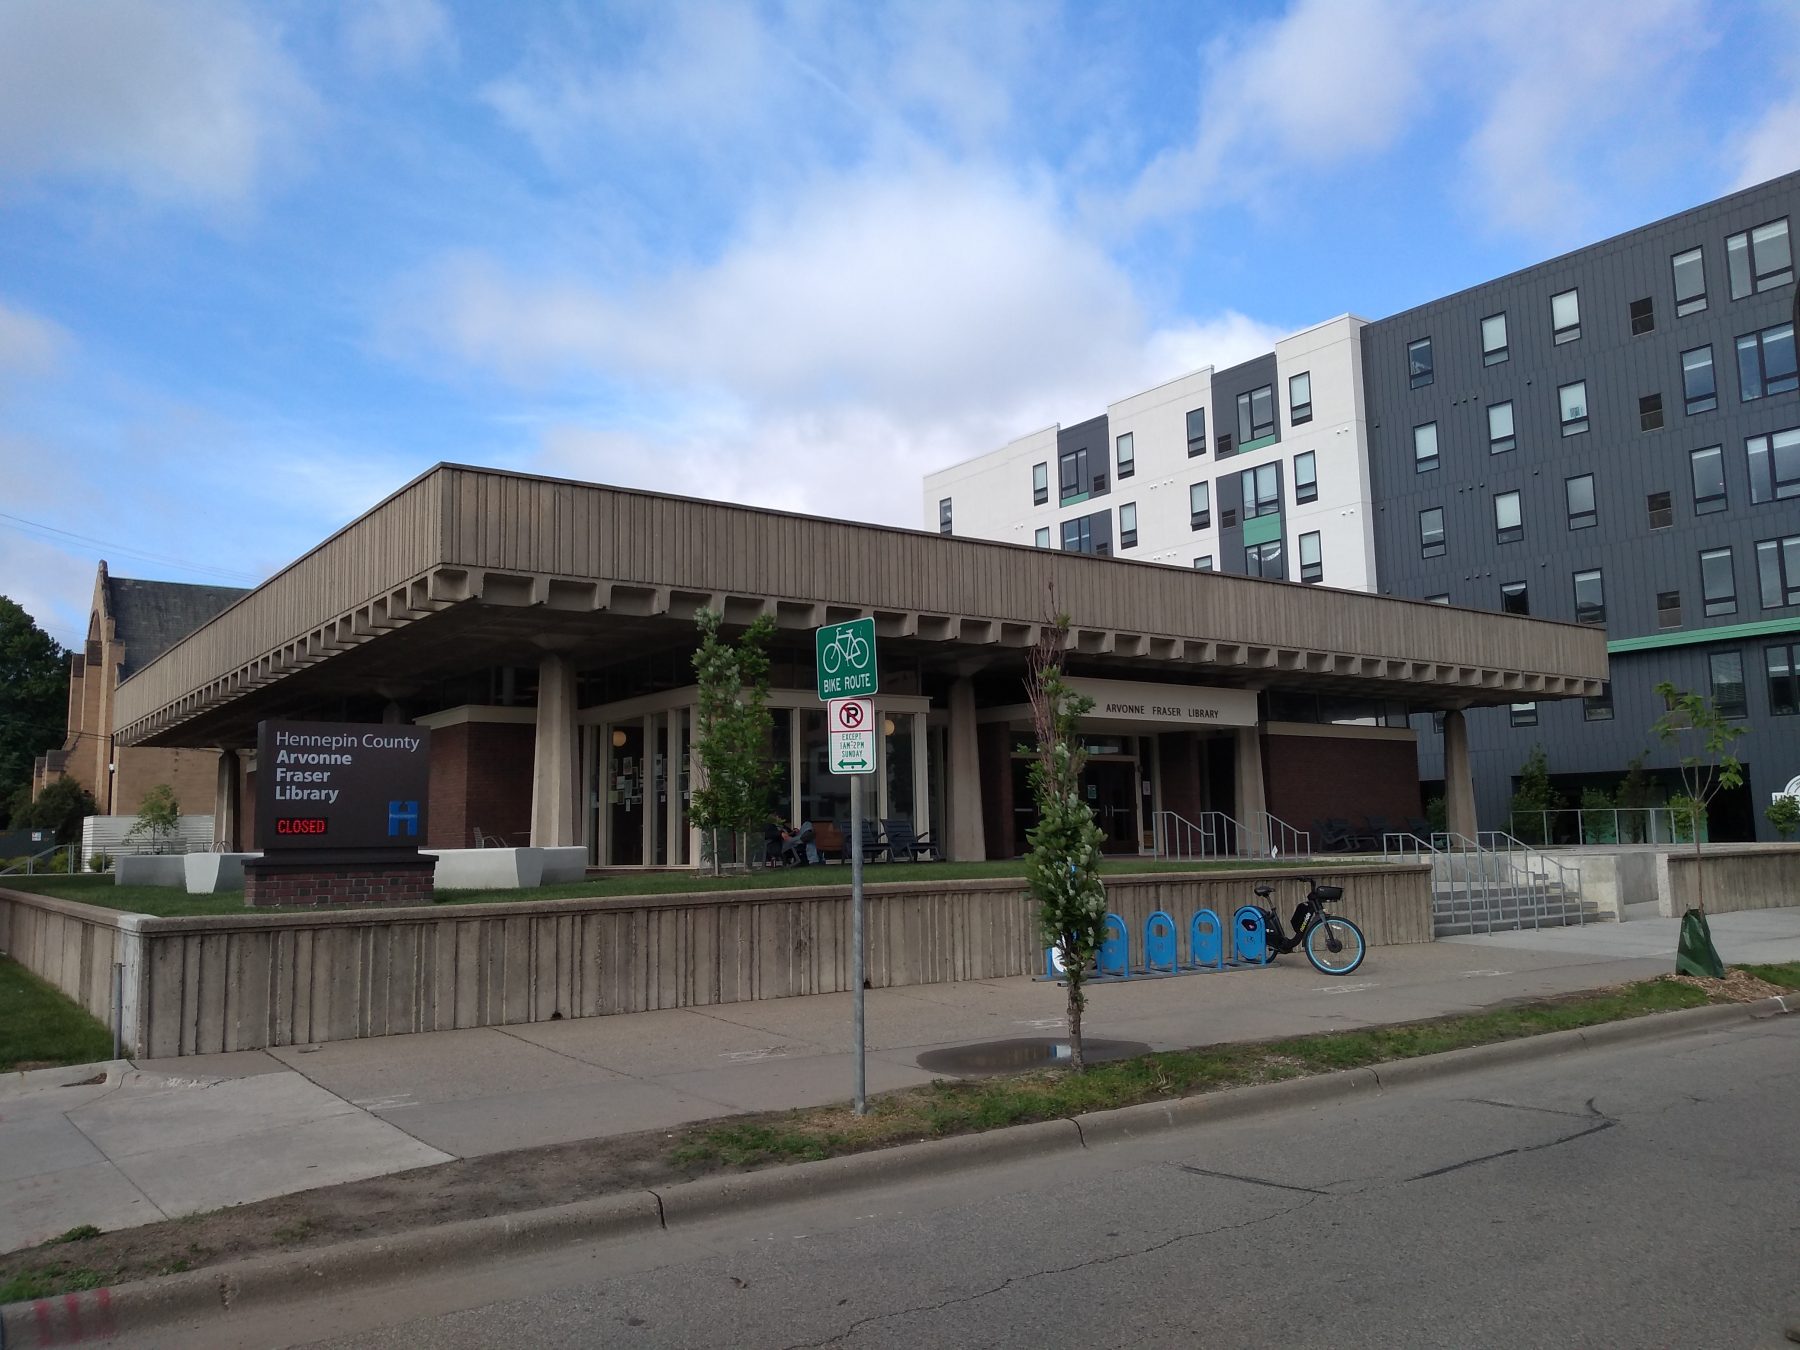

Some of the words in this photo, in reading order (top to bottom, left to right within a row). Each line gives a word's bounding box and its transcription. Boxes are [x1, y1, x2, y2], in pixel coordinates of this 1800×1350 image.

[824, 678, 841, 692] BIKE
[845, 674, 871, 690] ROUTE
[1106, 703, 1145, 715] ARVONNE
[1152, 706, 1181, 717] FRASER
[1188, 708, 1219, 719] LIBRARY
[276, 731, 358, 750] Hennepin
[362, 733, 420, 752] County
[841, 733, 862, 741] EXCEPT
[276, 750, 352, 765] Arvonne
[841, 750, 863, 758] SUNDAY
[276, 767, 331, 783] Fraser
[275, 785, 339, 804] Library
[277, 819, 325, 833] CLOSED
